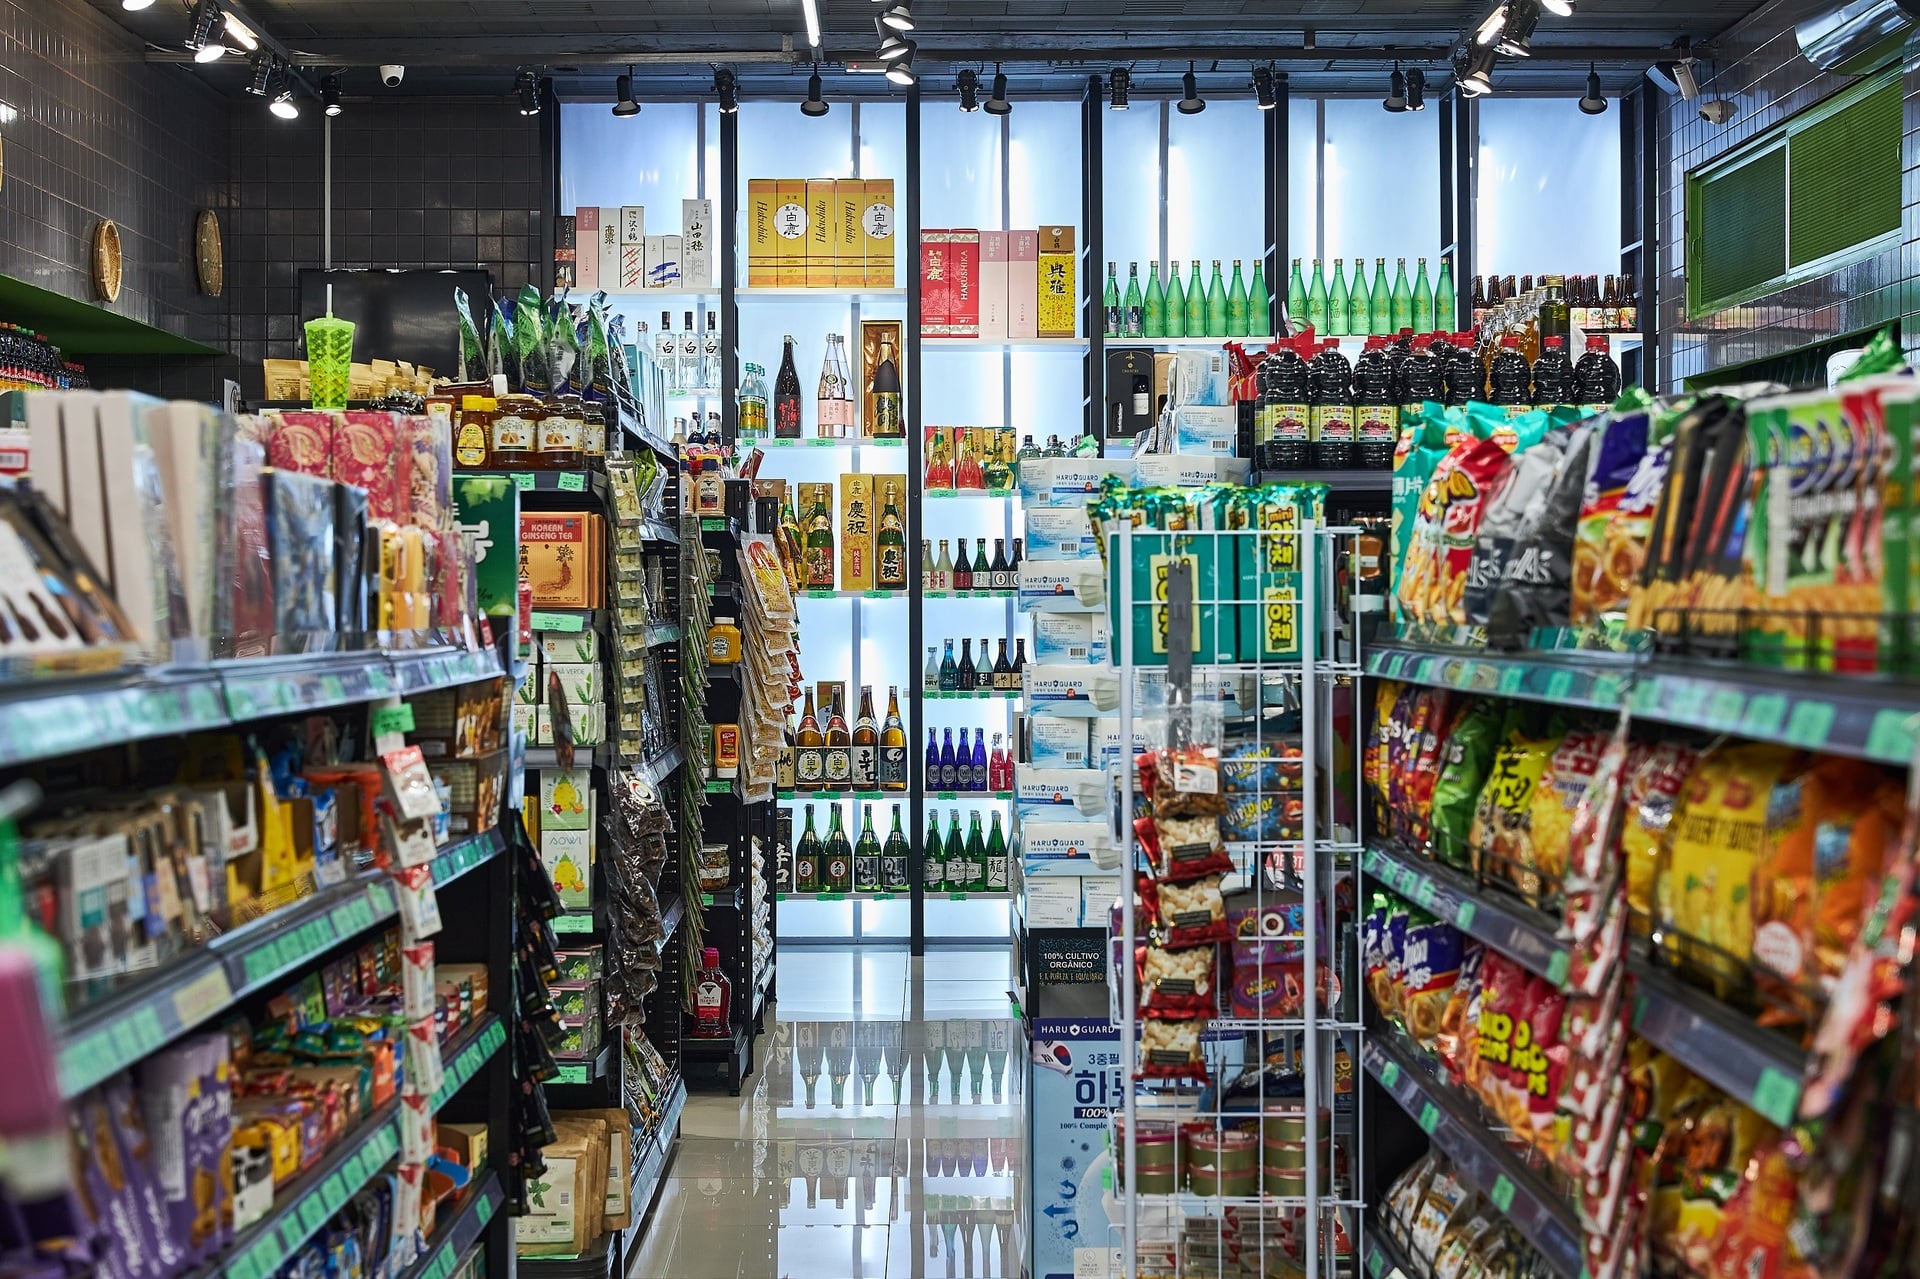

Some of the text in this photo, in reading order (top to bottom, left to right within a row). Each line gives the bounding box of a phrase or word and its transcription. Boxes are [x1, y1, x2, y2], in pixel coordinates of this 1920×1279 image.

[757, 200, 768, 244] Hakushika
[815, 200, 826, 243] Hakushika
[845, 200, 856, 244] Hakushika
[960, 249, 968, 300] HAKUSHIKA
[847, 500, 868, 536] 慶祝
[1269, 507, 1294, 522] mini
[521, 532, 557, 540] GINSENG
[531, 524, 563, 532] KOREAN
[519, 544, 530, 578] 高麗人
[1268, 603, 1292, 641] 야채
[1049, 960, 1093, 968] ORGÂNICO
[1088, 1053, 1120, 1065] 3중필
[1081, 1108, 1108, 1118] 100%
[1080, 1122, 1107, 1130] Comple
